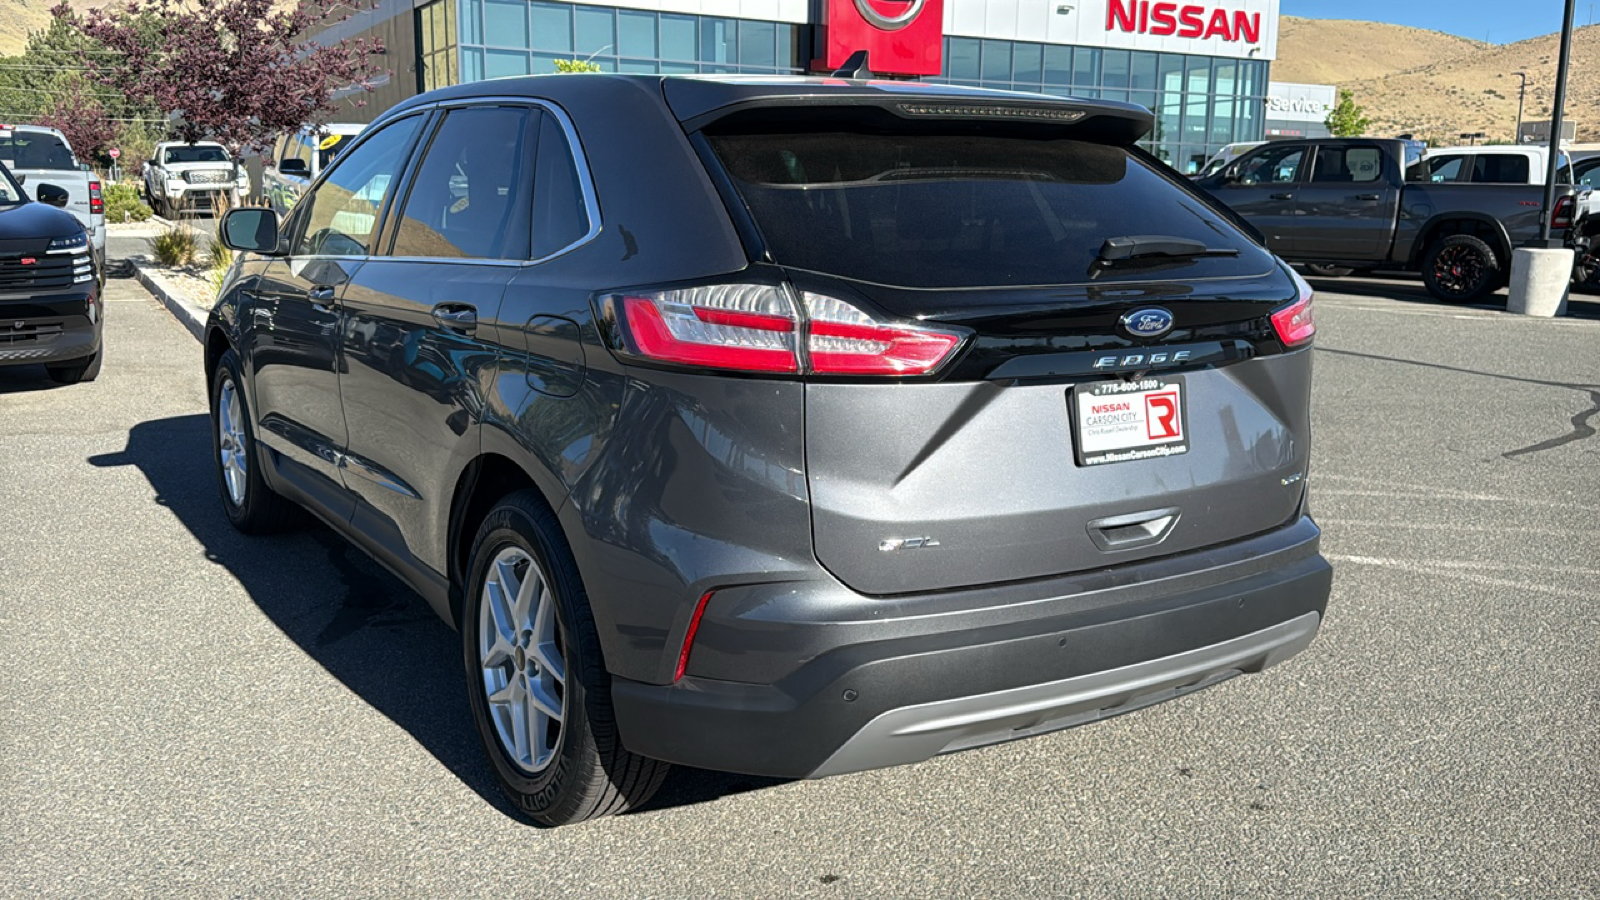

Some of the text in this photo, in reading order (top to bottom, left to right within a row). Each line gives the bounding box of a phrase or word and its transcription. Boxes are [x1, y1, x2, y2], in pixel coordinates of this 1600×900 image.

[1105, 0, 1261, 44] NISSAN
[1271, 95, 1321, 114] Service
[1138, 314, 1165, 330] Ford
[1093, 350, 1191, 367] EDGE
[1091, 402, 1131, 414] NISSAN
[1086, 411, 1138, 426] CARSON CITY
